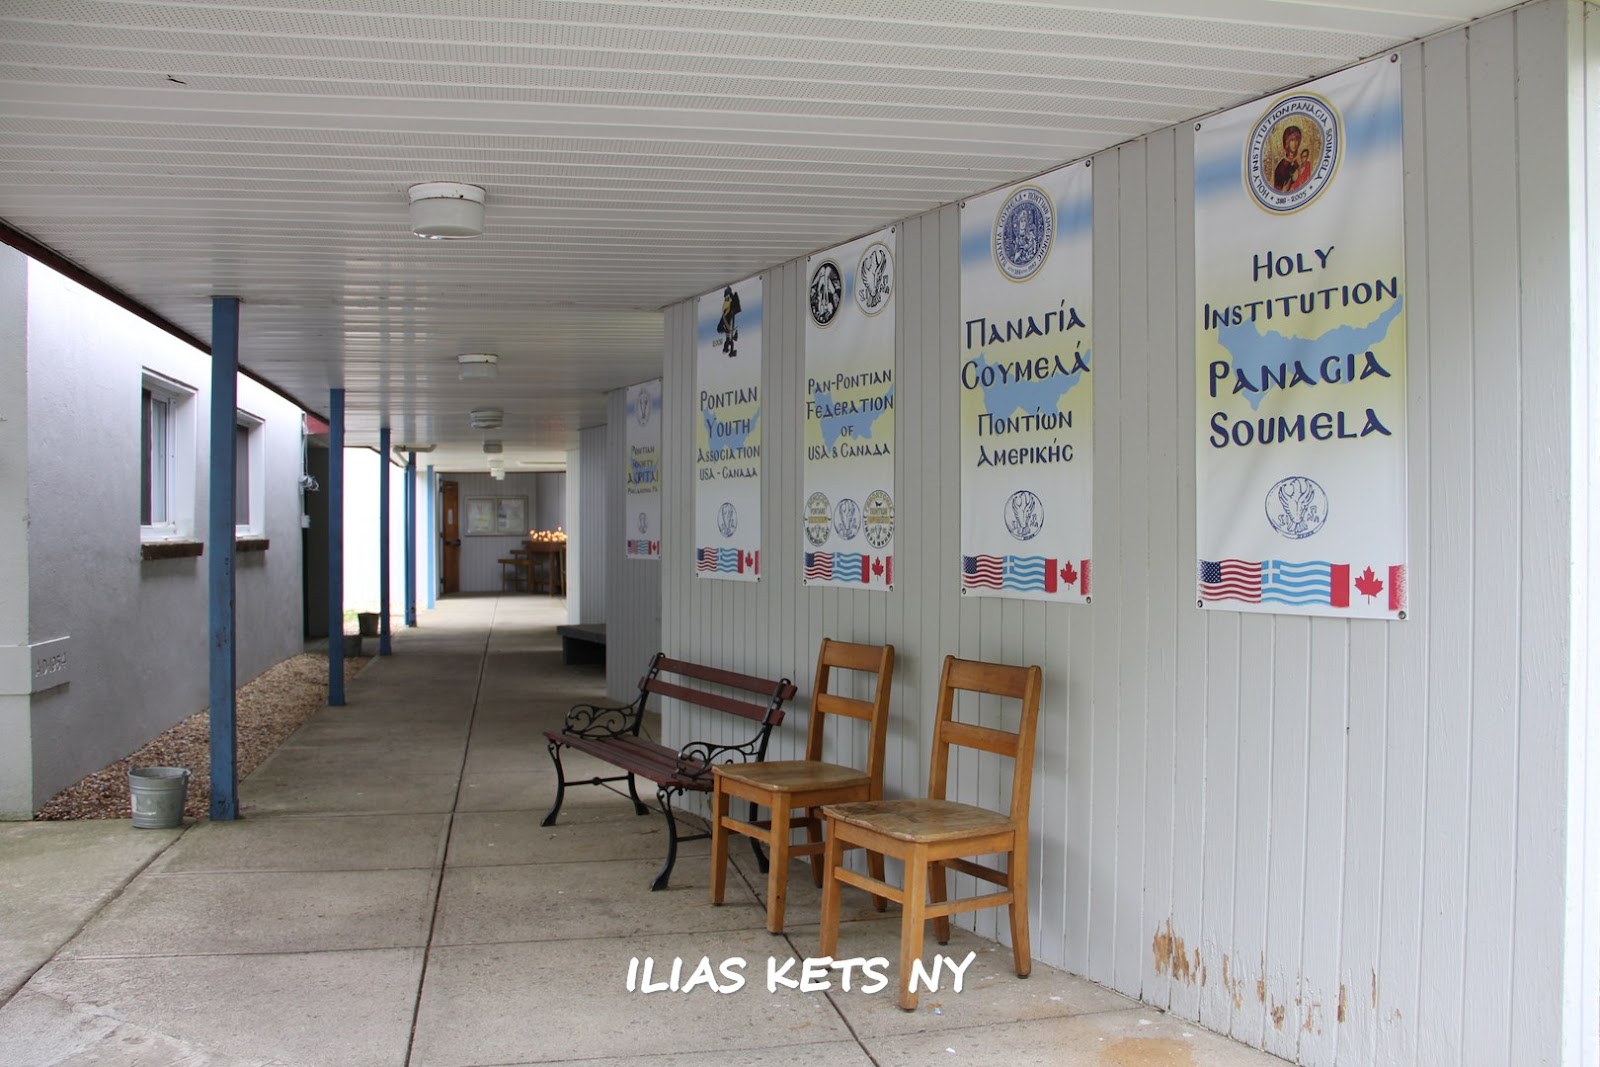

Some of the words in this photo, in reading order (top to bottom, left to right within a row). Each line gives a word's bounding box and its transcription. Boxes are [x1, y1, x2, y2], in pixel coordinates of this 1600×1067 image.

[1252, 246, 1335, 282] HOLY
[1204, 276, 1397, 330] INSTITUTION
[807, 369, 892, 395] PAN-PONTIAN
[1209, 351, 1392, 397] PANAGIA
[700, 386, 758, 411] PONTIAN
[805, 395, 894, 420] FEDERATION
[706, 418, 750, 439] YOUTH
[840, 425, 854, 438] OF
[1210, 408, 1392, 448] SOUMELA
[697, 445, 760, 463] ASSOCIATION
[808, 445, 829, 461] USA
[841, 443, 890, 459] CANADA
[700, 467, 715, 480] USA
[722, 466, 758, 479] CANADA
